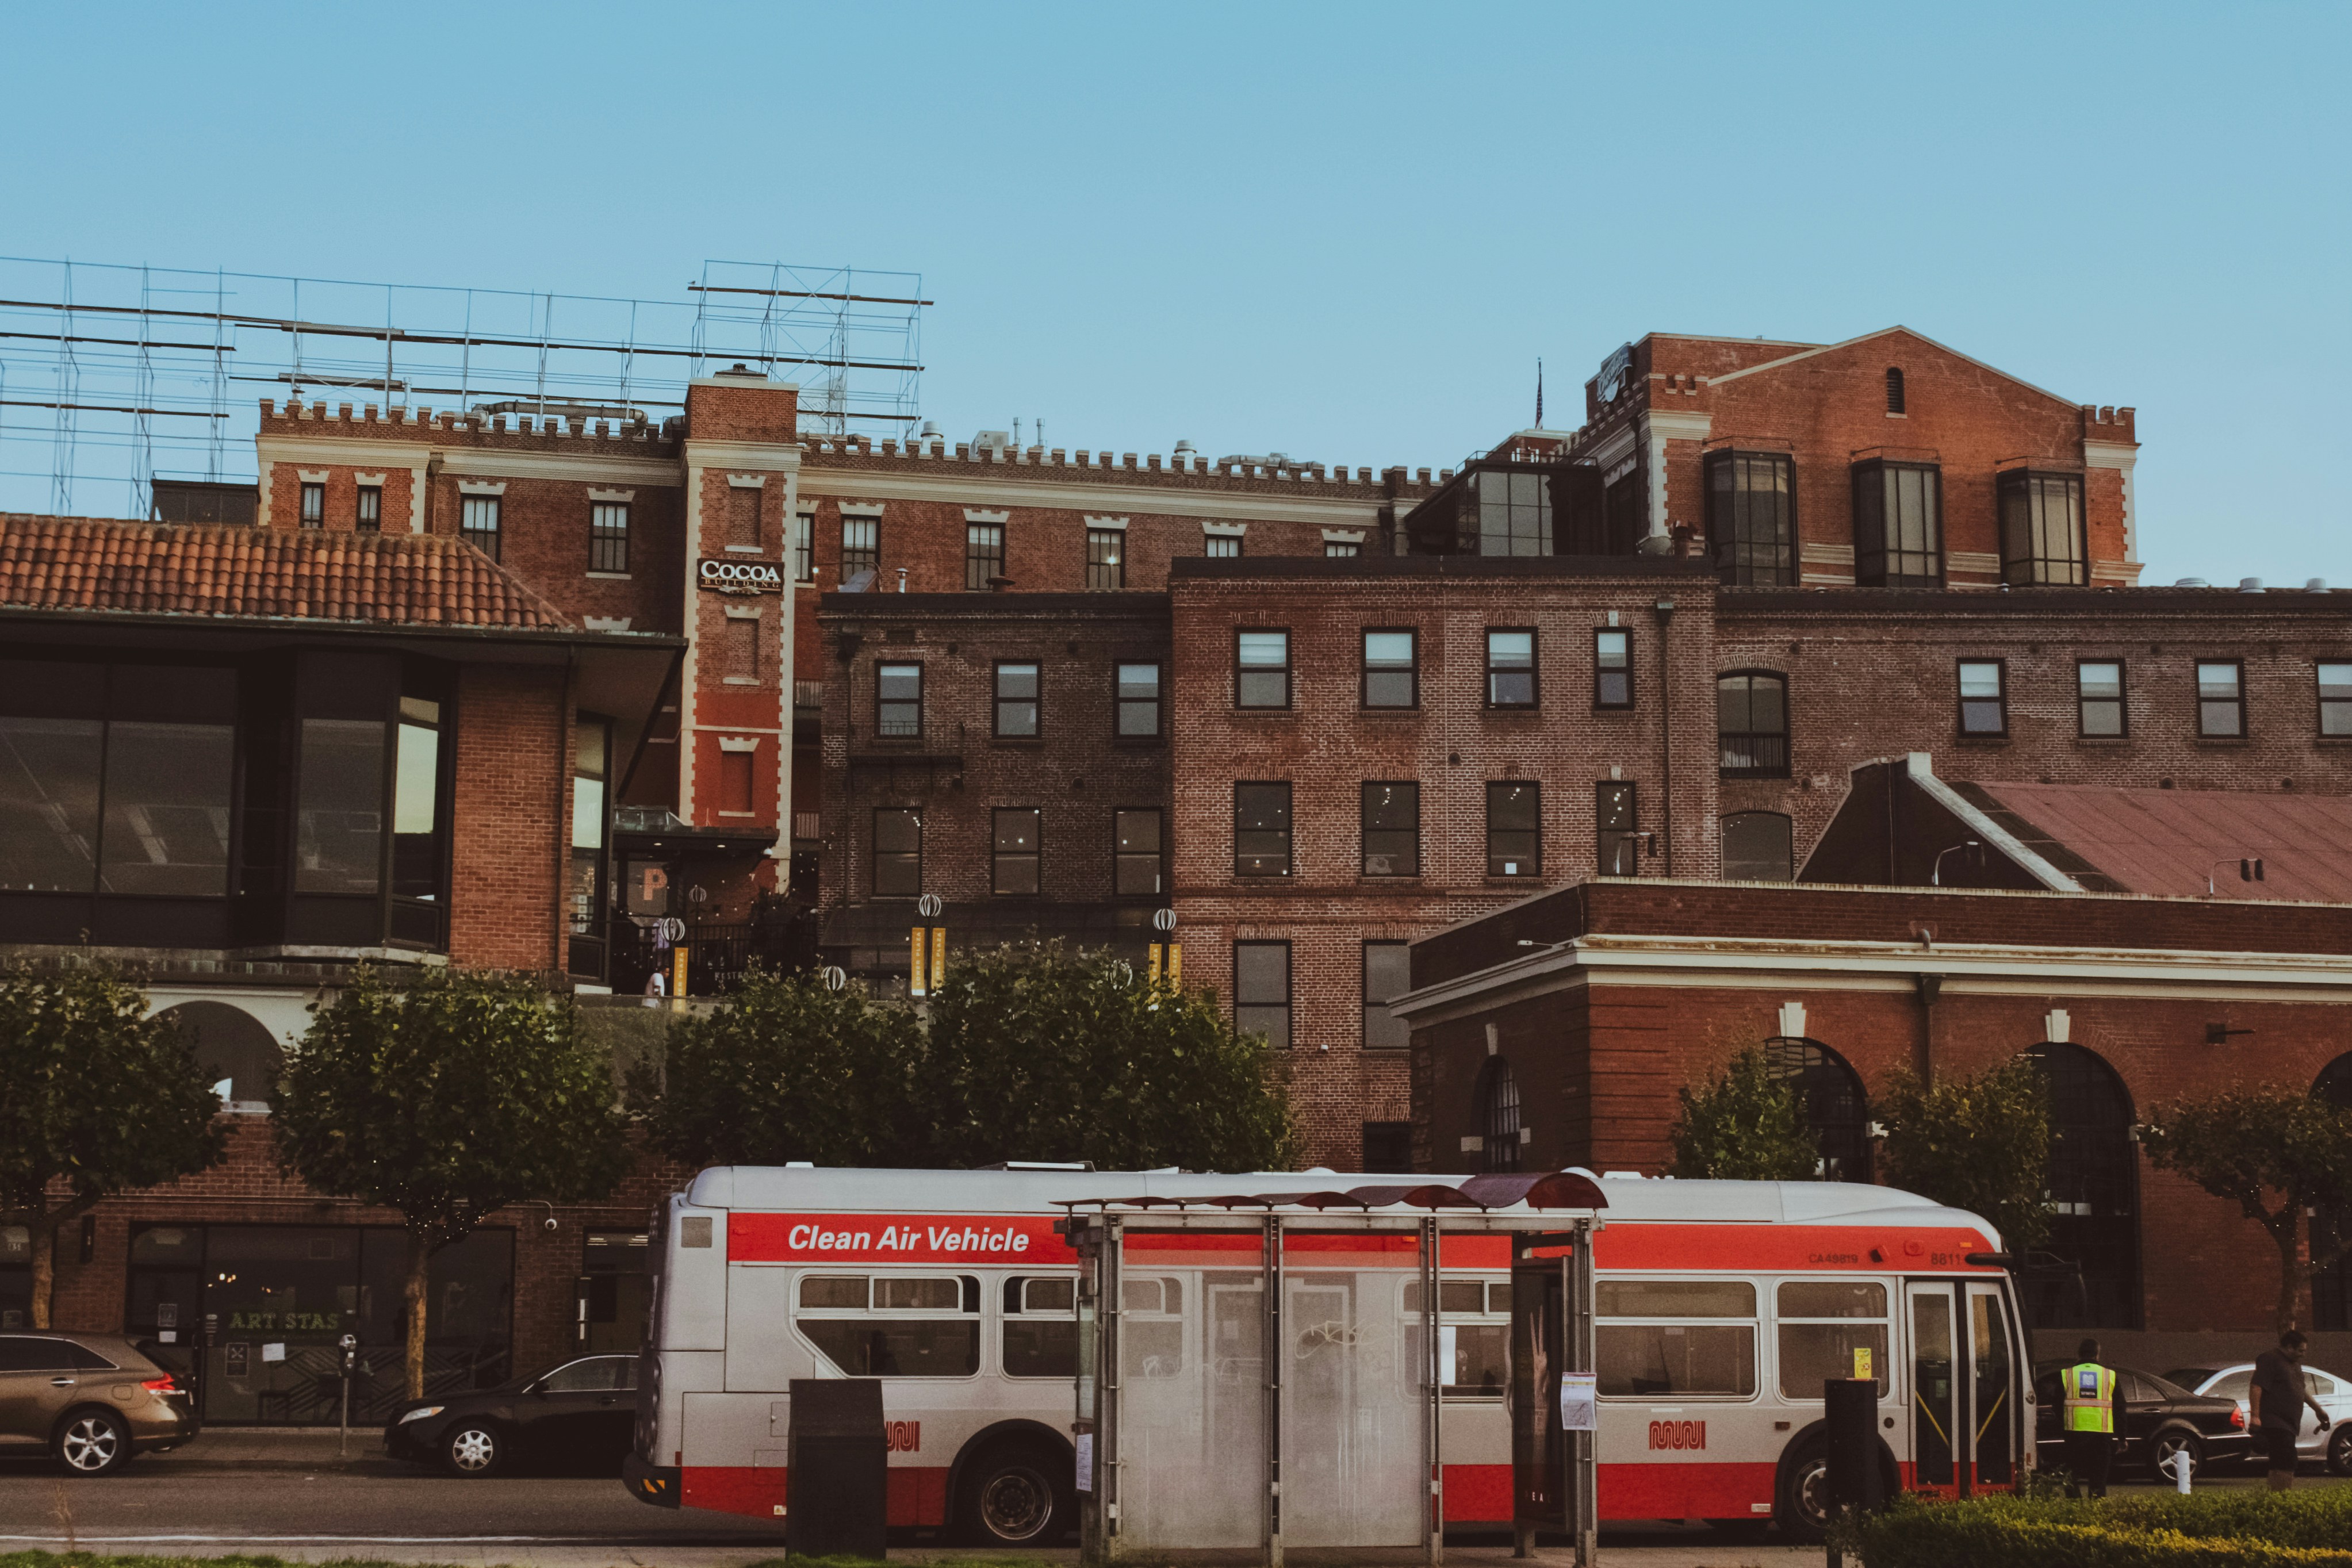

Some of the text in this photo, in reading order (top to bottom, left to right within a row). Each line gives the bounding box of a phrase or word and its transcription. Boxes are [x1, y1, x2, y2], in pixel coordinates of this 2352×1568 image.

[701, 561, 781, 581] COCOA
[704, 578, 779, 588] BUILDING
[788, 1225, 1029, 1251] Clean Air Vehicle
[1930, 1252, 1961, 1265] 8811
[229, 1312, 339, 1329] ARTSTAS
[1649, 1421, 1706, 1450] MUNI
